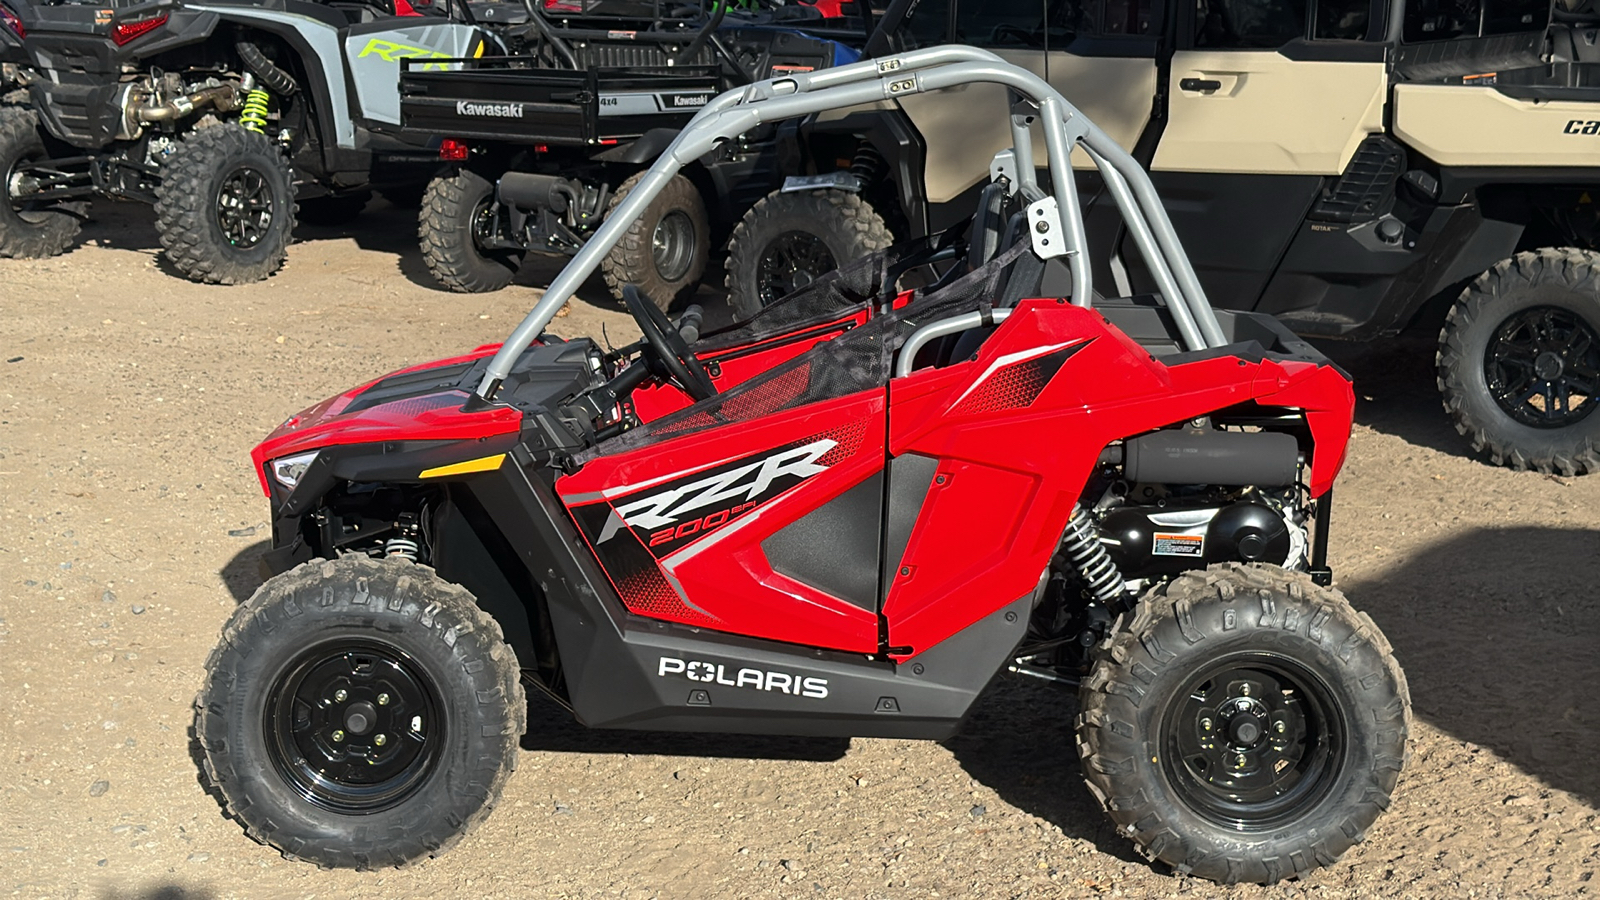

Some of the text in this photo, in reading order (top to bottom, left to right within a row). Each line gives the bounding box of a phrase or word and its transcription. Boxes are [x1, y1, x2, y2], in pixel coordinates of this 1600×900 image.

[456, 99, 523, 118] Kawasaki
[600, 97, 618, 106] 4x4
[674, 95, 708, 106] Kawasaki
[1563, 119, 1600, 135] ca
[596, 438, 839, 546] RZR
[649, 509, 731, 547] 200
[658, 656, 829, 699] POLARIS
